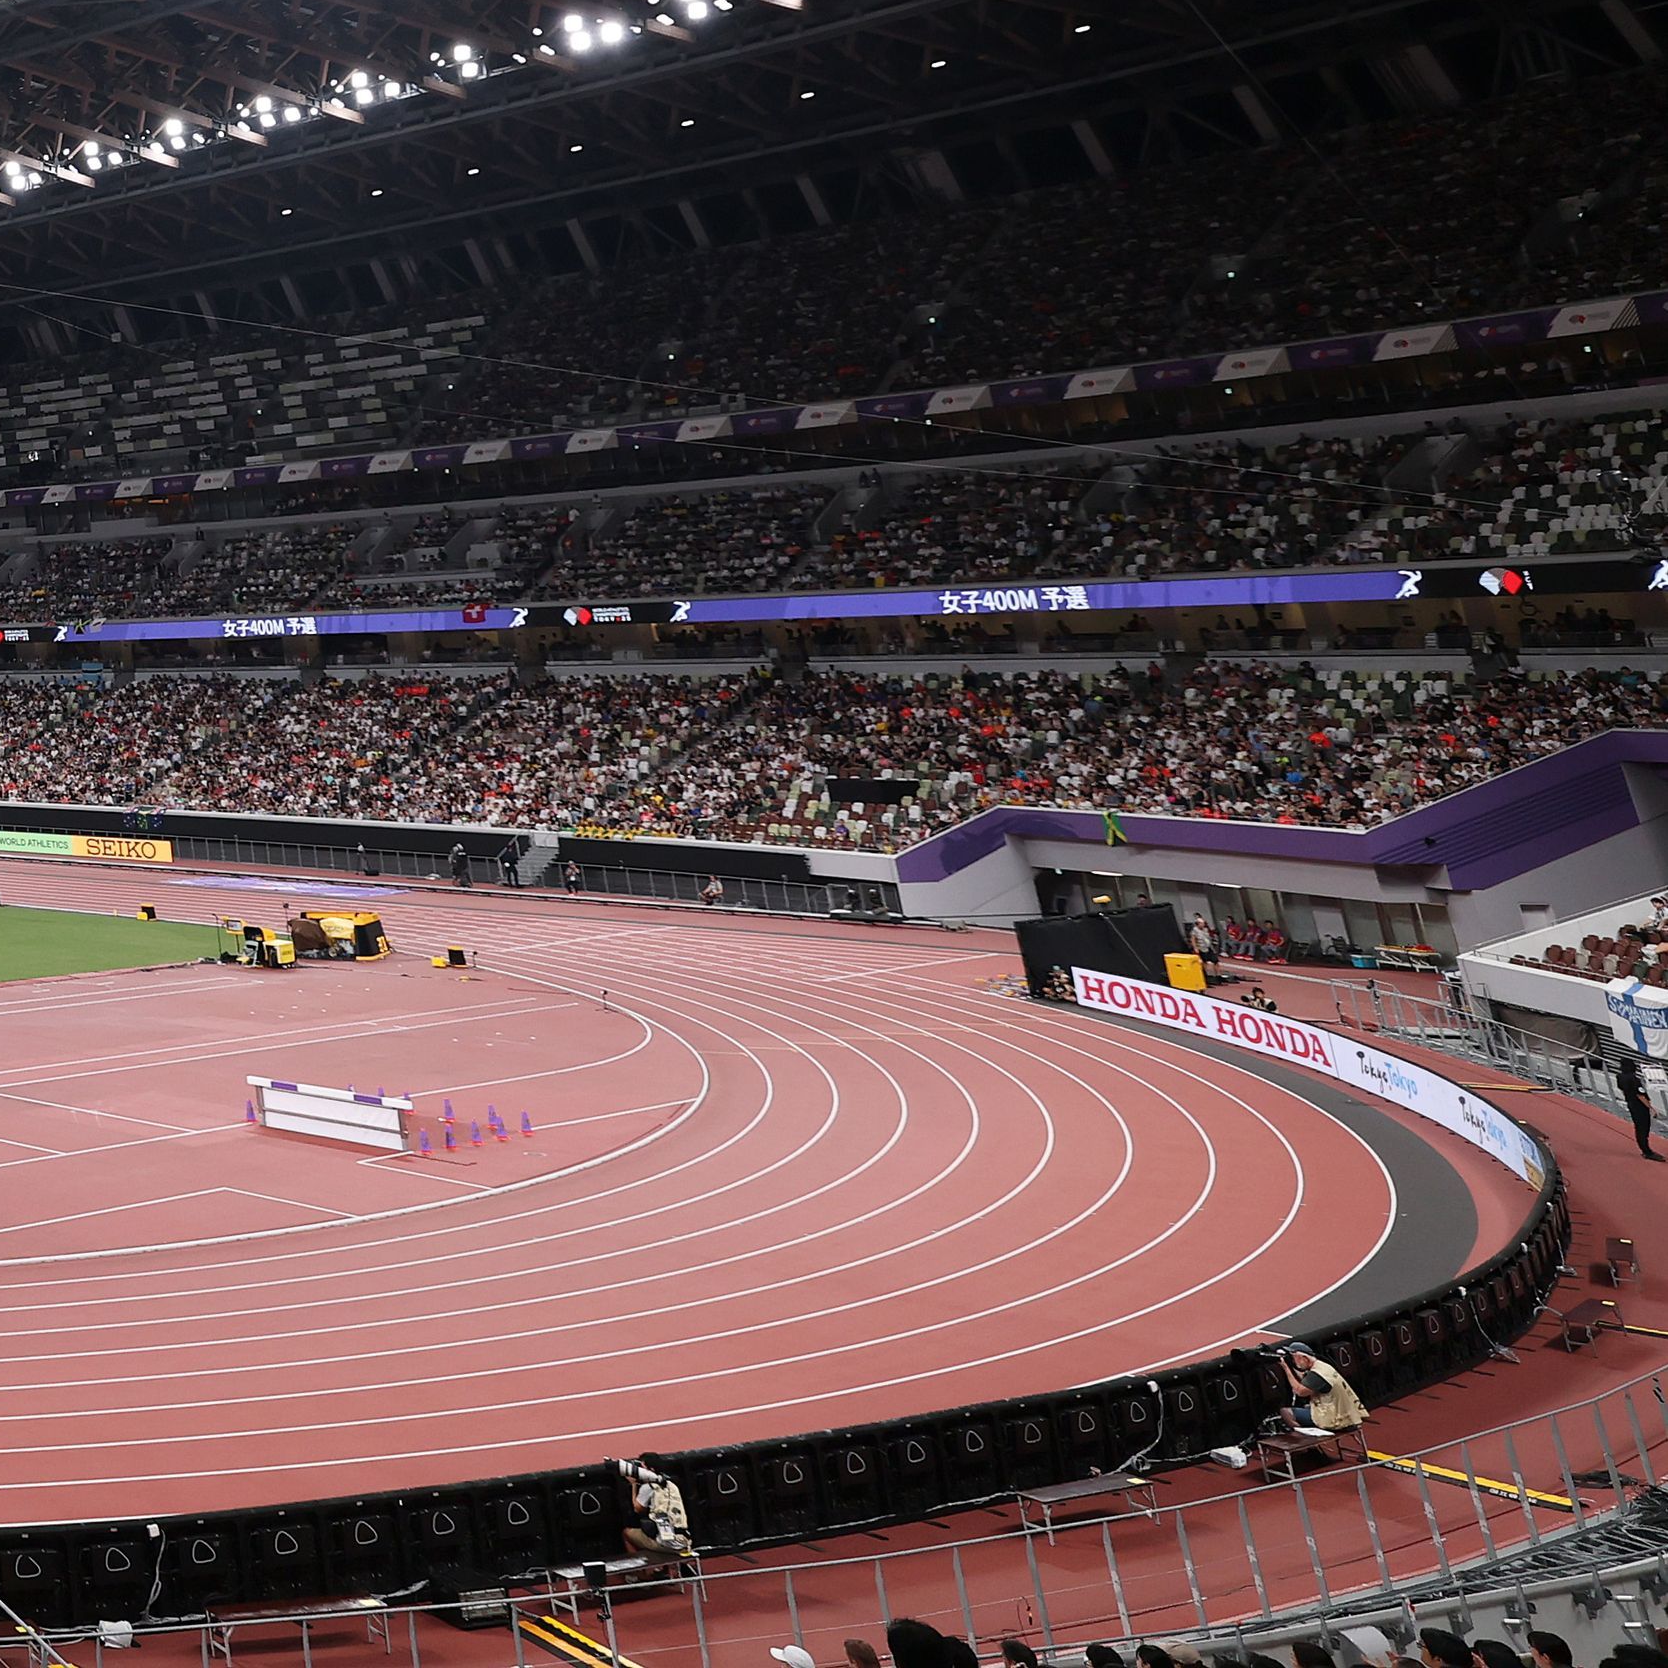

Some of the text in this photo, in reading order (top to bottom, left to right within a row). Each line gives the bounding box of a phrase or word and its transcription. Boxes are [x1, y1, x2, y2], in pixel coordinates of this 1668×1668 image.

[939, 585, 1091, 615] 女子400M 予選
[222, 616, 318, 638] 女子400M 予選
[0, 837, 69, 850] WORLD ATHLETICS
[86, 838, 157, 859] SEIKO
[1079, 975, 1332, 1068] HONDA HONDA
[1356, 1051, 1418, 1099] Tokyo Tokyo
[1458, 1096, 1486, 1145] Tokyo
